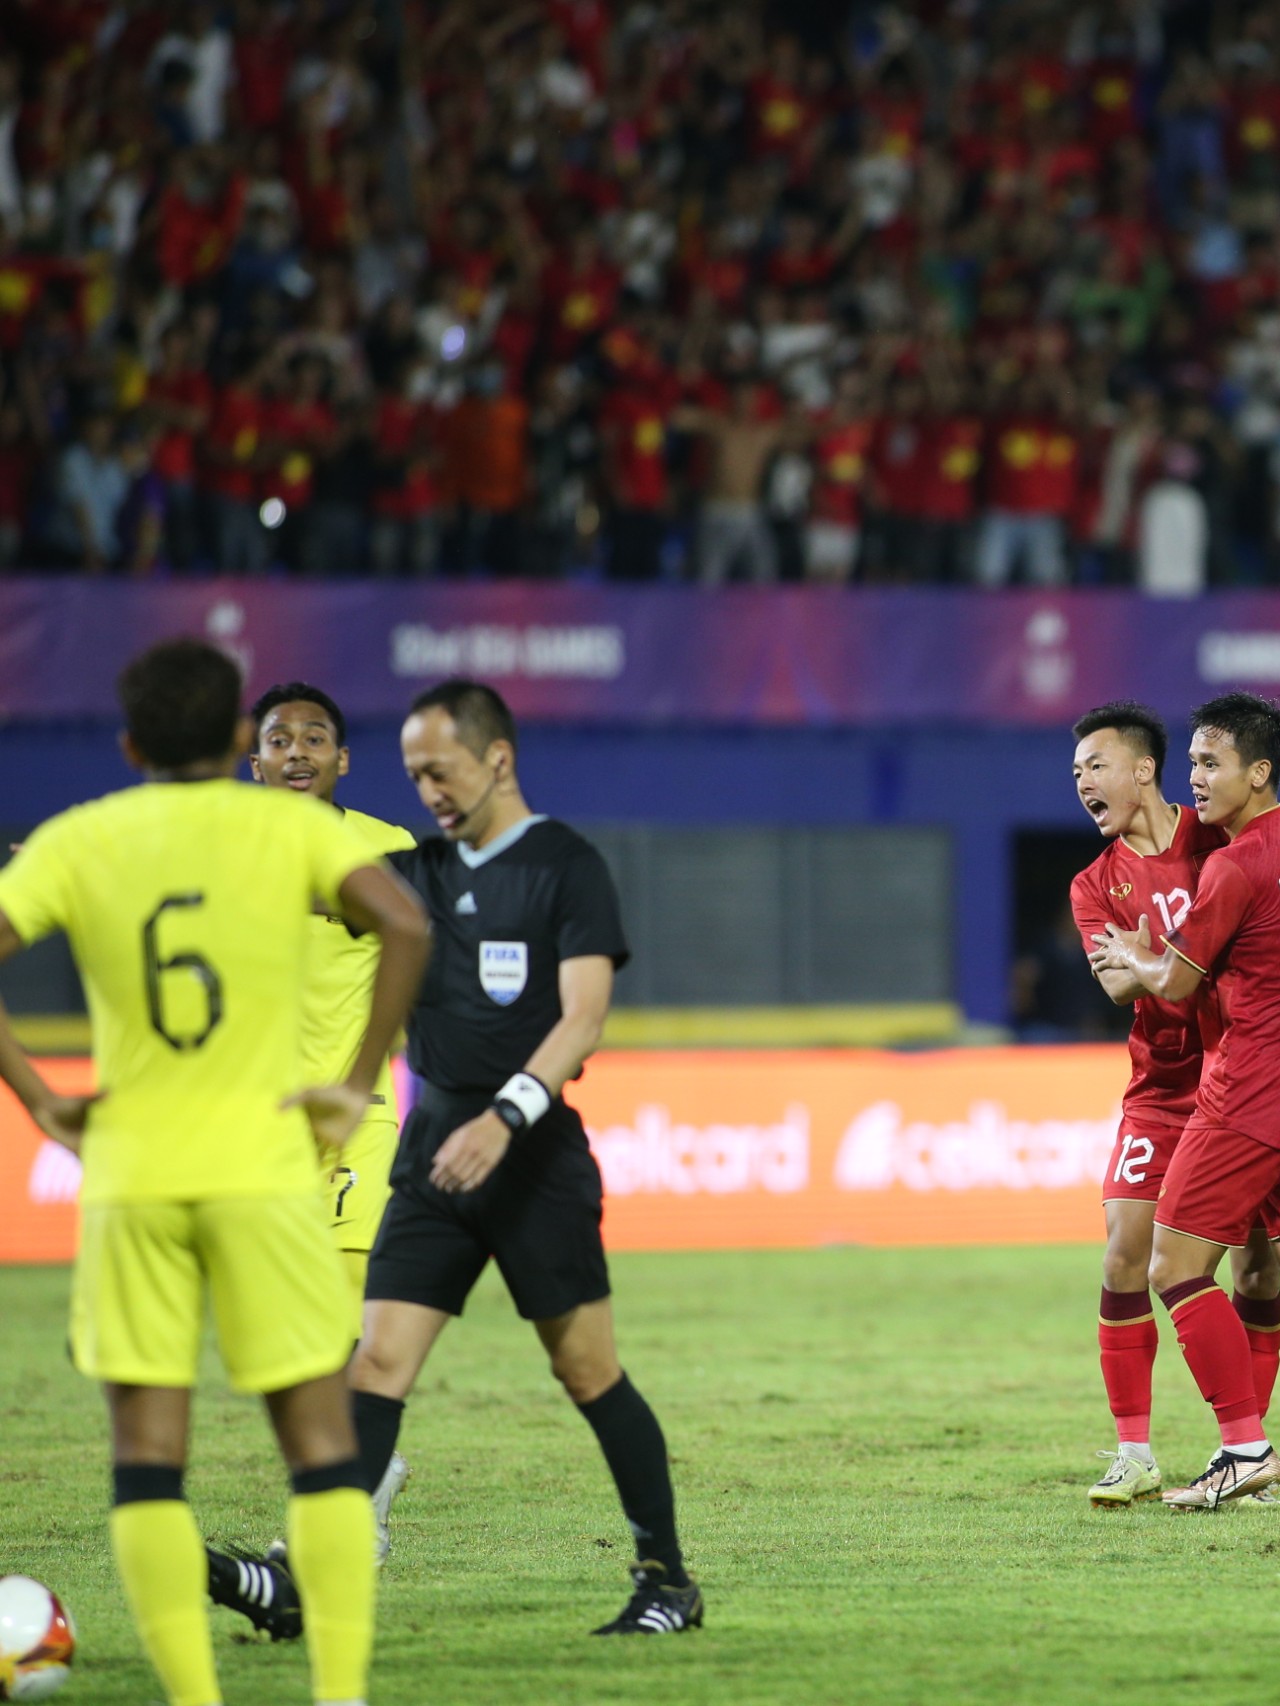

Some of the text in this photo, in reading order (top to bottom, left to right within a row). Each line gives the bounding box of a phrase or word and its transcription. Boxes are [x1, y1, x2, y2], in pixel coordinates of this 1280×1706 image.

[1151, 887, 1192, 932] 12
[141, 892, 224, 1055] 6
[1113, 1134, 1155, 1184] 12
